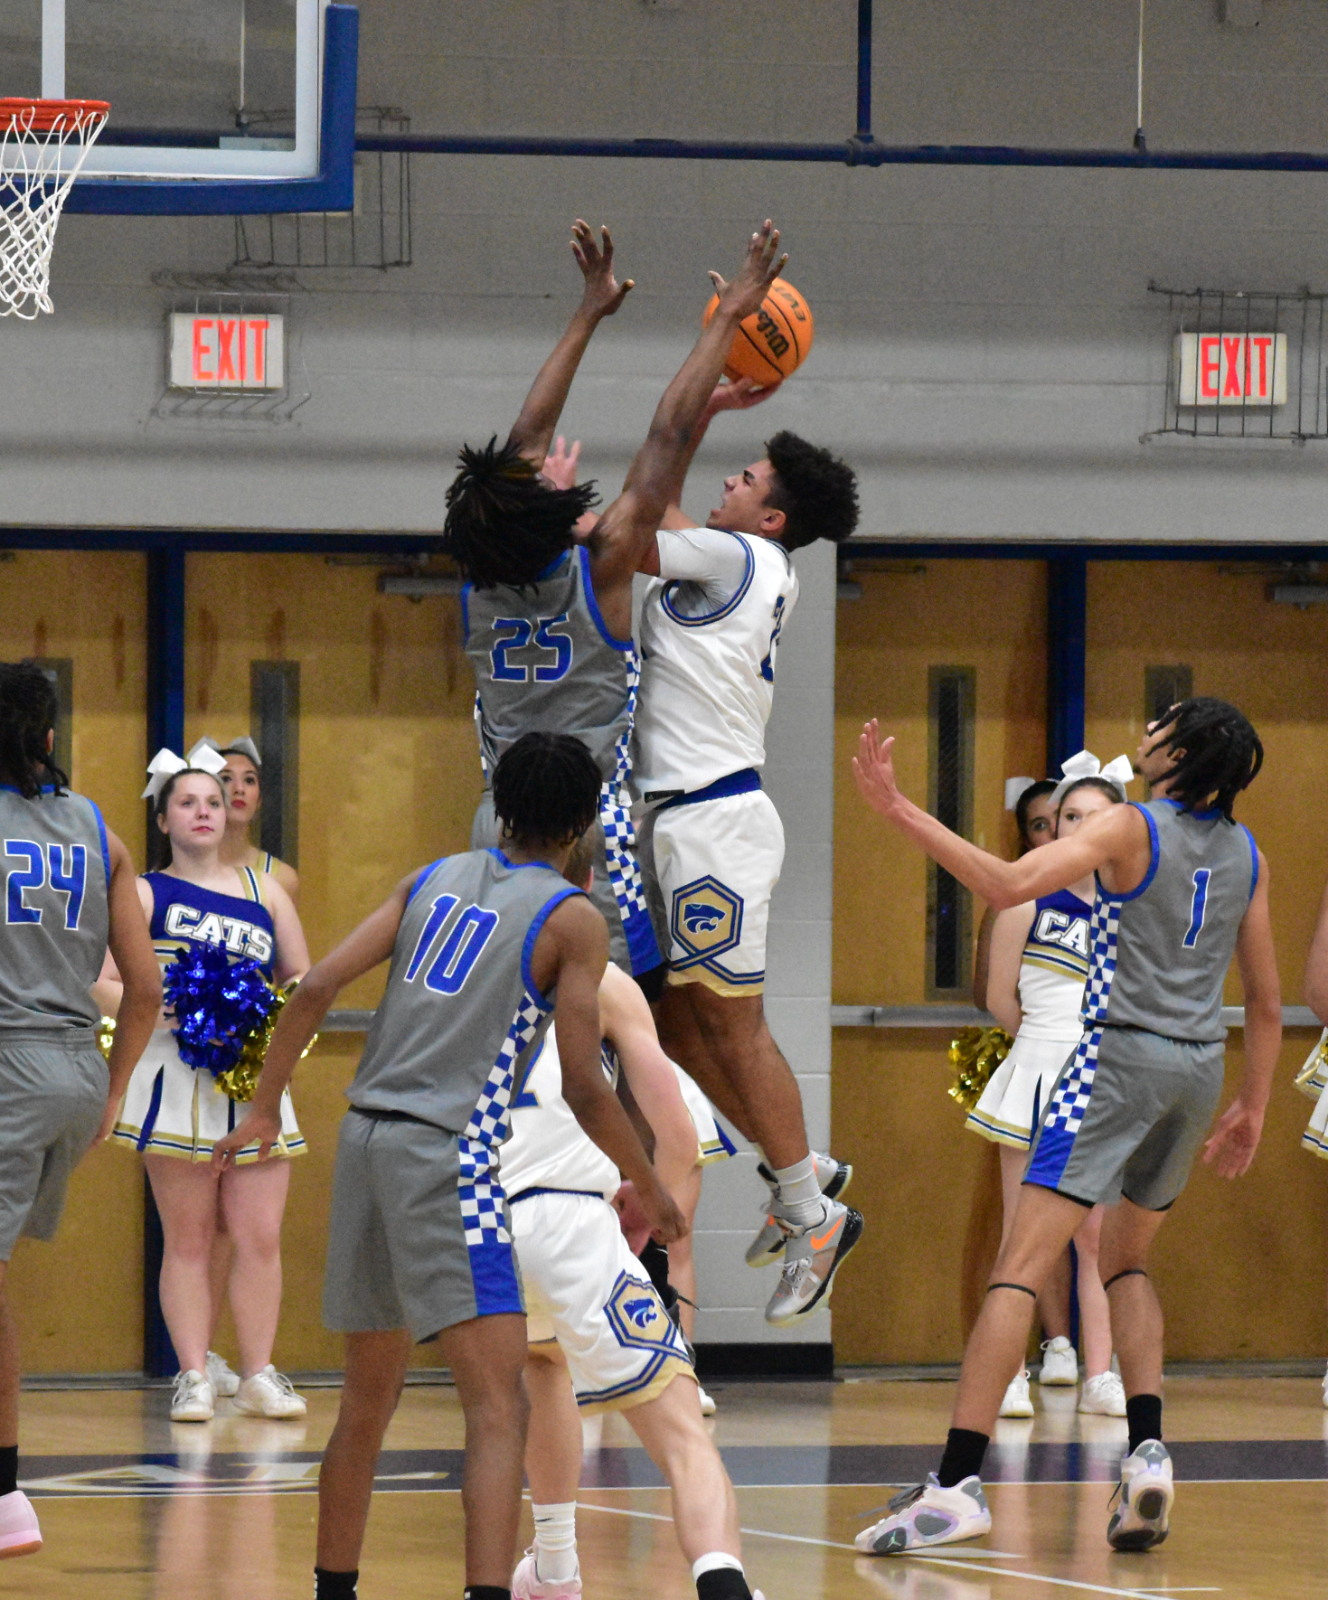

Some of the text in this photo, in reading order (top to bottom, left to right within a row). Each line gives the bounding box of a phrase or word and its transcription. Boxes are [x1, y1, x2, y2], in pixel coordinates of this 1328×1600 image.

[192, 319, 269, 381] EXIT
[757, 309, 790, 359] Wils
[1200, 337, 1272, 397] EXIT
[489, 612, 573, 683] 25
[4, 839, 87, 931] 24
[1182, 867, 1212, 950] 1
[164, 903, 273, 964] CATS
[403, 893, 500, 996] 10
[1034, 908, 1091, 959] CA
